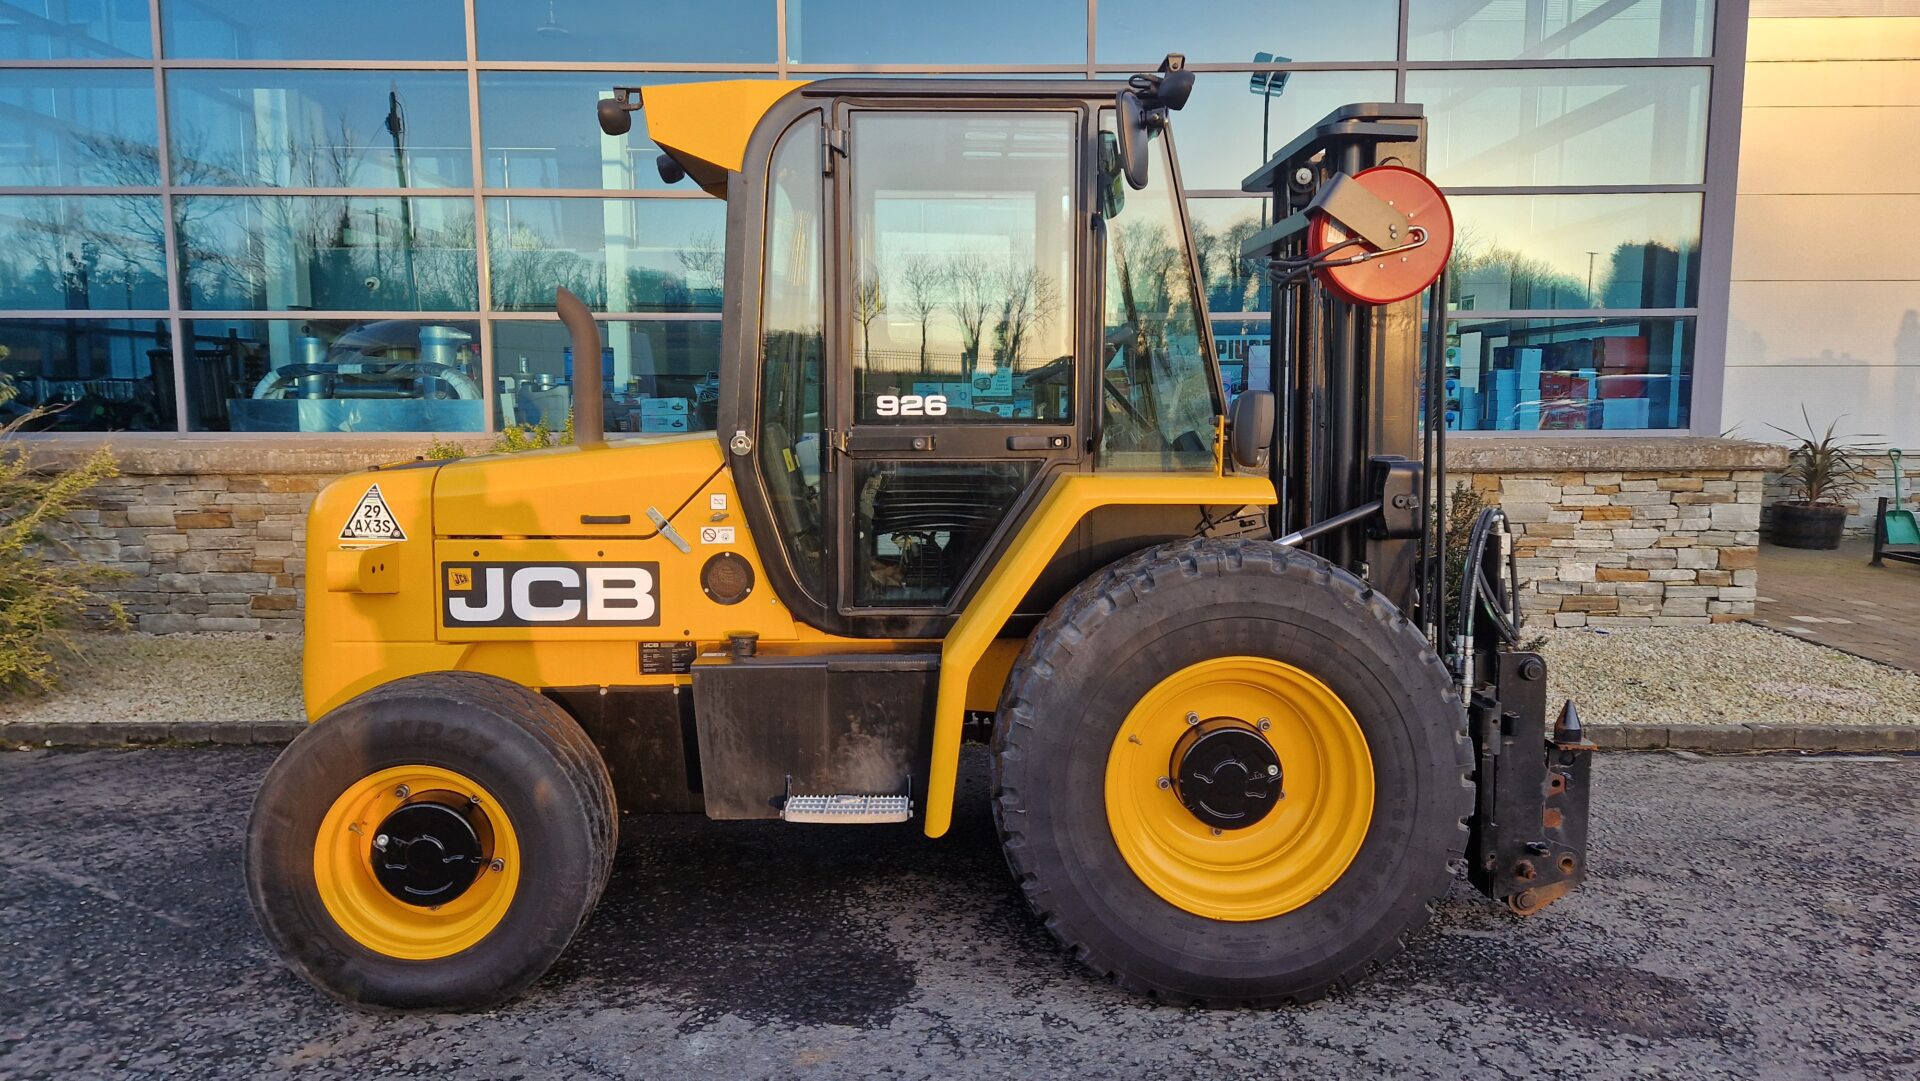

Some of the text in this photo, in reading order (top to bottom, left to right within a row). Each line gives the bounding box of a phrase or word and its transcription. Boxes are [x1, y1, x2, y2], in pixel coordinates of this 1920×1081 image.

[876, 395, 947, 416] 926
[364, 505, 381, 518] 29
[355, 519, 391, 533] AX3S
[454, 572, 469, 585] JCB
[448, 567, 655, 621] JCB
